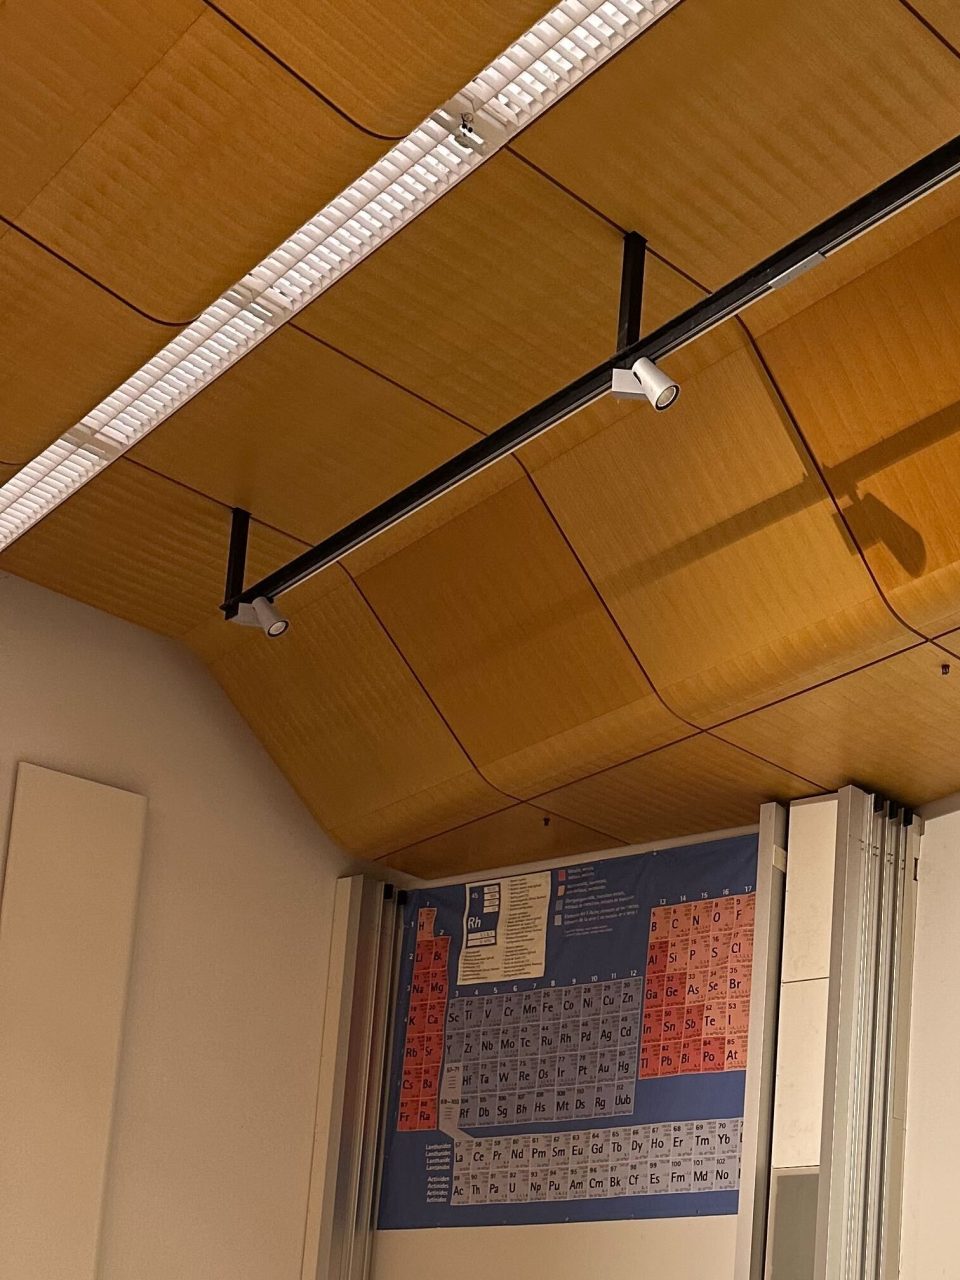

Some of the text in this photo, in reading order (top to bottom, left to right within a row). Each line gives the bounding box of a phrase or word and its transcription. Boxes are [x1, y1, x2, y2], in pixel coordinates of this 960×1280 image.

[714, 912, 720, 922] O
[736, 910, 742, 920] F
[468, 916, 482, 929] Rh
[672, 919, 678, 929] C
[692, 916, 700, 926] N
[652, 922, 657, 932] B
[712, 947, 718, 958] S
[732, 942, 740, 954] Cl
[669, 952, 676, 962] Si
[690, 950, 696, 960] P
[708, 981, 718, 992] Se
[730, 979, 742, 989] Br
[688, 985, 700, 995] As
[705, 1016, 716, 1026] Te
[703, 1052, 715, 1062] Po
[726, 1050, 738, 1060] At
[651, 1138, 664, 1148] Ho
[673, 1137, 683, 1147] Er
[695, 1136, 709, 1146] Tm
[718, 1134, 730, 1144] Yb
[572, 1146, 583, 1155] Eu
[592, 1143, 603, 1154] Gd
[612, 1142, 622, 1152] Tb
[632, 1140, 643, 1152] Dy
[493, 1151, 502, 1160] Pr
[511, 1148, 523, 1159] Nd
[532, 1148, 546, 1158] Pm
[552, 1146, 565, 1157] Sm
[456, 1153, 463, 1162] La
[473, 1152, 484, 1162] Ce
[629, 1175, 639, 1185] Cf
[650, 1174, 660, 1184] Es
[672, 1172, 685, 1182] Fm
[694, 1171, 708, 1181] Md
[716, 1170, 728, 1180] No
[549, 1181, 560, 1190] Pu
[570, 1180, 583, 1190] Am
[590, 1178, 603, 1188] Cm
[610, 1176, 621, 1187] Bk
[472, 1185, 480, 1194] Th
[490, 1184, 498, 1193] Pa
[510, 1183, 516, 1192] U
[530, 1182, 541, 1193] Np
